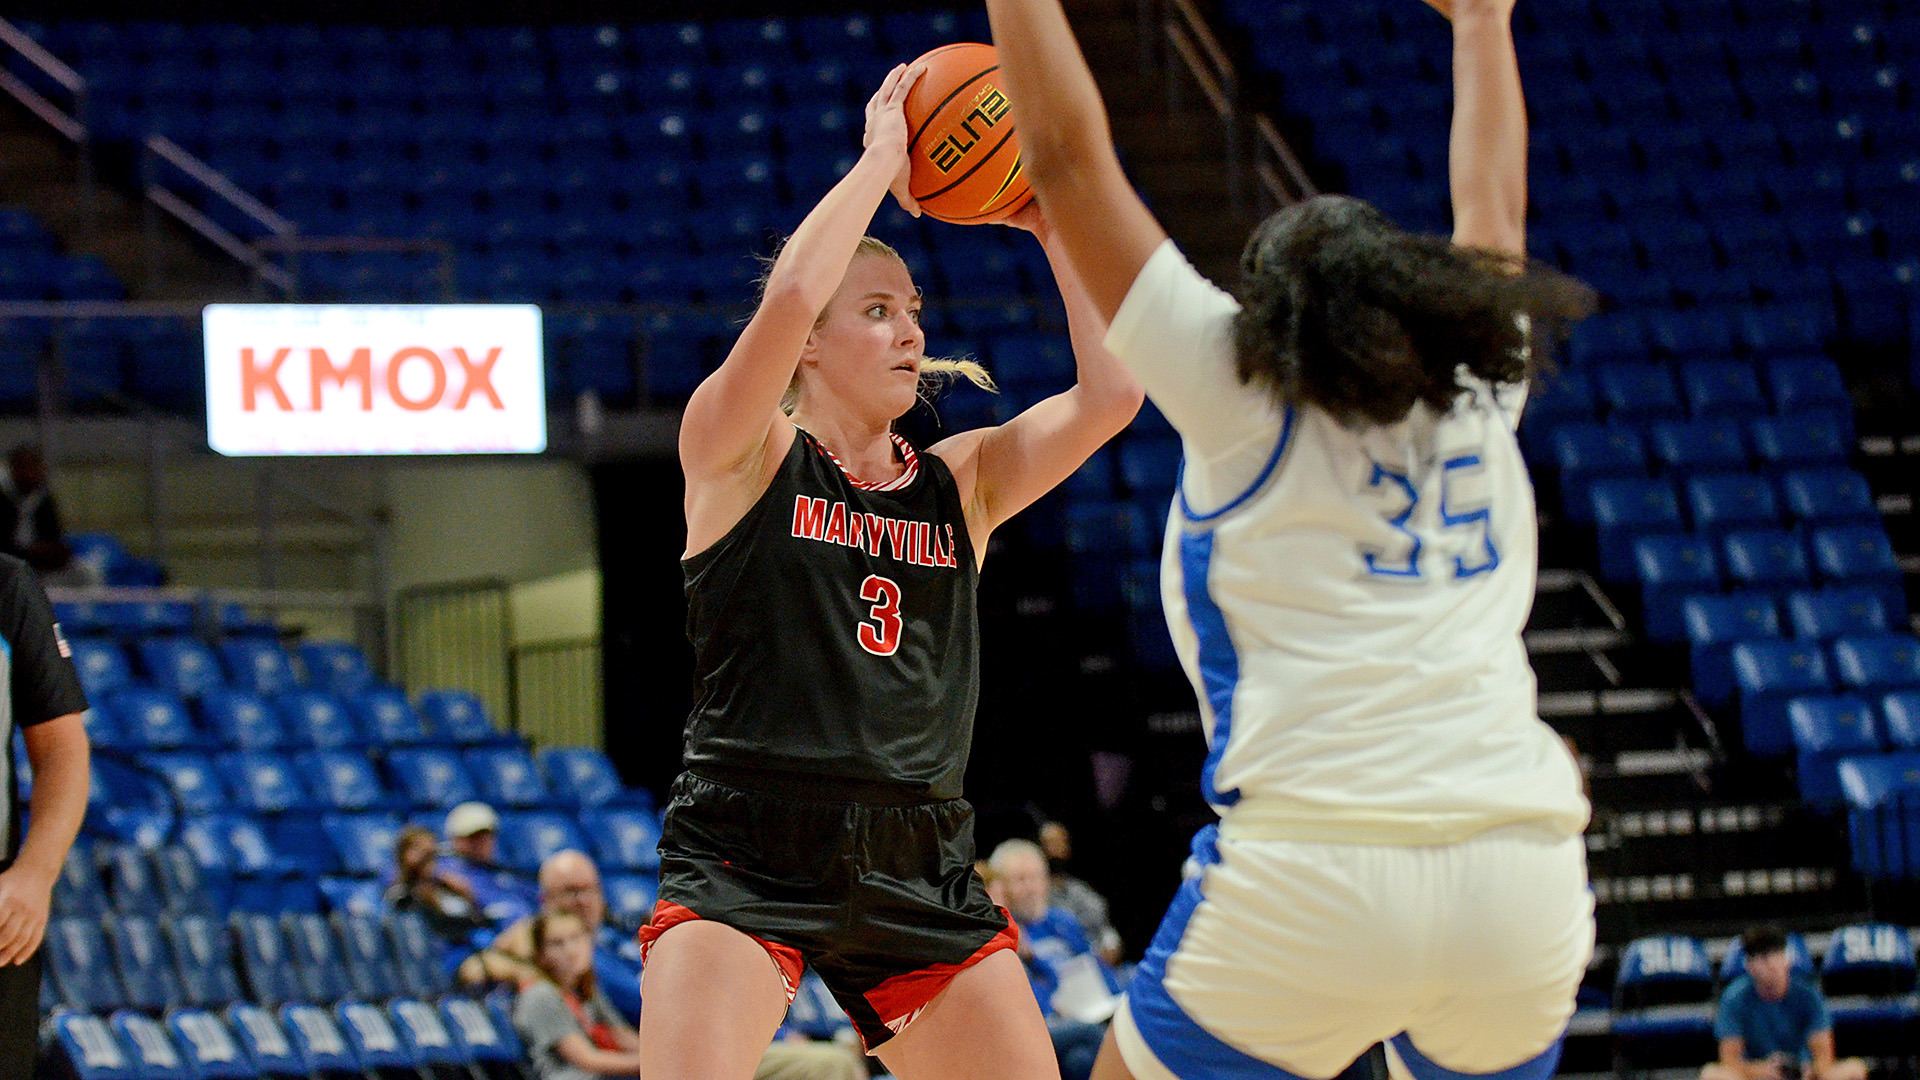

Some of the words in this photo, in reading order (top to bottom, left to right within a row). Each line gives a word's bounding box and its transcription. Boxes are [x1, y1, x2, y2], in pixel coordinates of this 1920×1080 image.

[239, 346, 506, 412] KMOX
[791, 494, 957, 569] MARYVILLE
[1361, 452, 1501, 581] 35
[857, 573, 904, 657] 3
